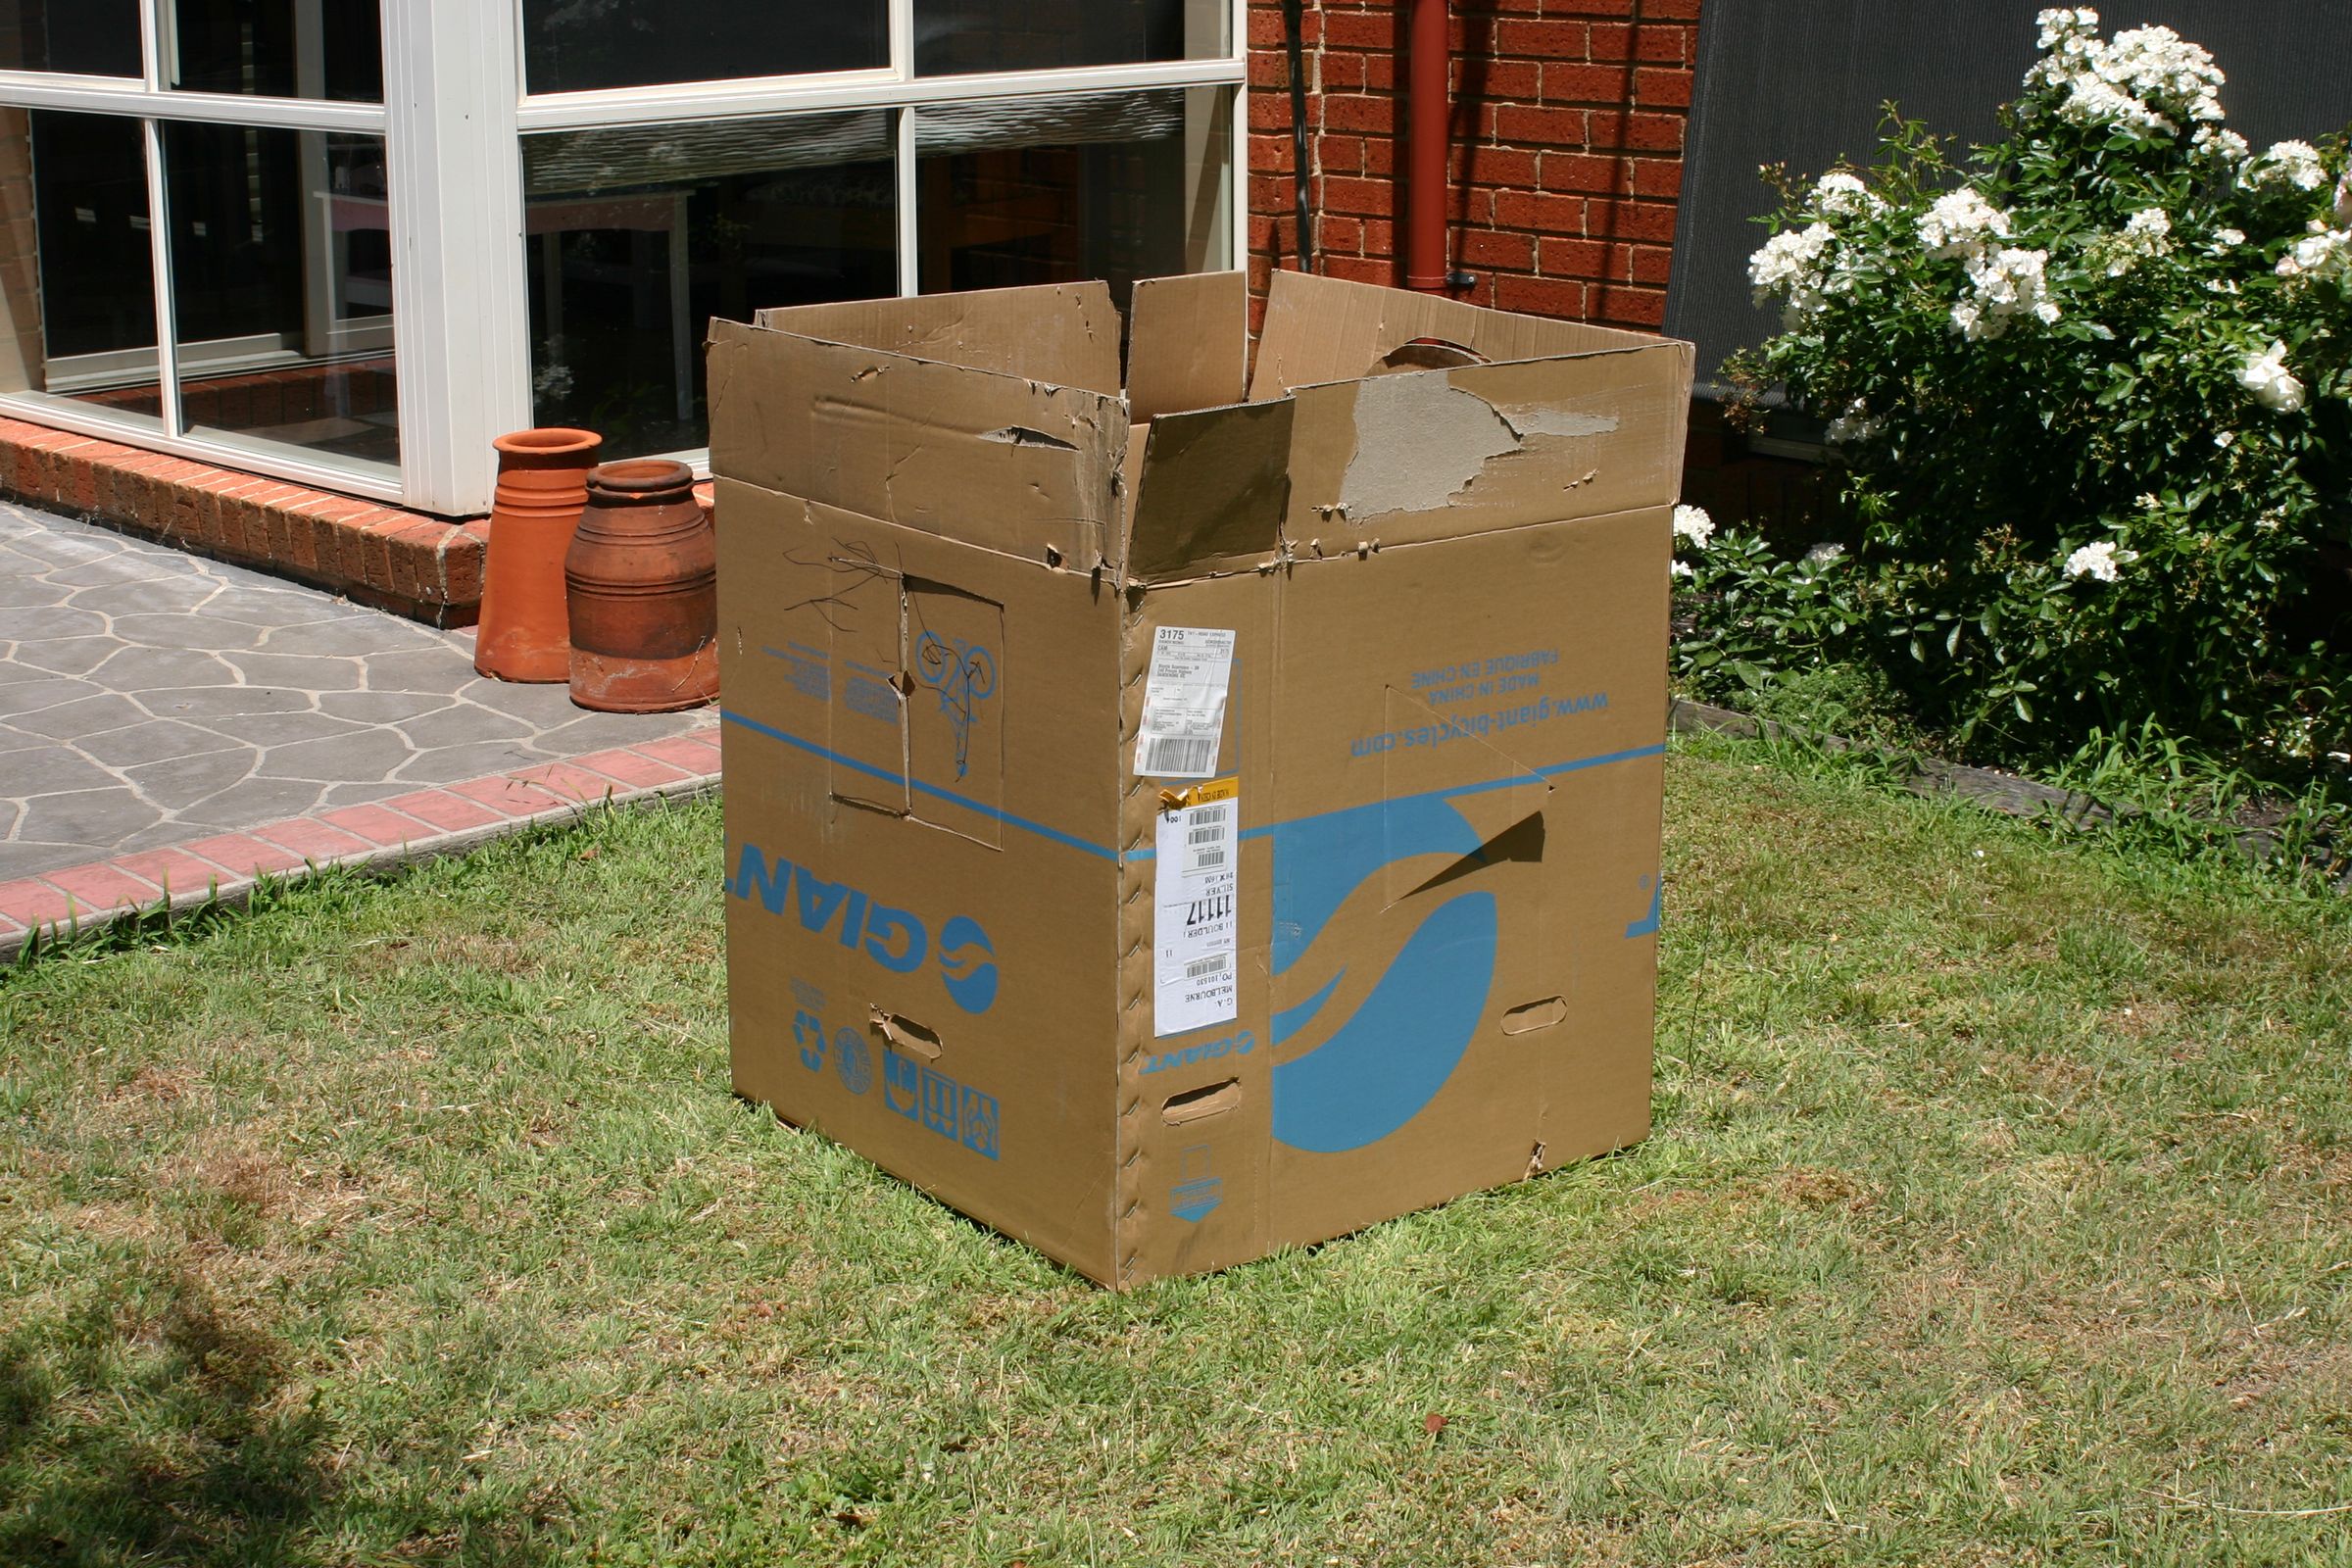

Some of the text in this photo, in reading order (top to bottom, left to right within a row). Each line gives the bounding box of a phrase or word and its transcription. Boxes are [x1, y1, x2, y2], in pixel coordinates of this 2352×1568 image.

[1159, 629, 1185, 640] 3175
[1410, 648, 1559, 689] FABRIQUE EN CHINE
[1428, 672, 1540, 706] MADE IN CHINA
[1350, 692, 1608, 757] www.giant-bicycles.com
[1205, 882, 1234, 897] SILVER
[724, 843, 928, 973] GIAN
[1187, 895, 1232, 926] 11117
[1187, 922, 1224, 939] BOULDER
[1184, 984, 1233, 1003] MELBOURNE
[1139, 1037, 1233, 1075] GIANT
